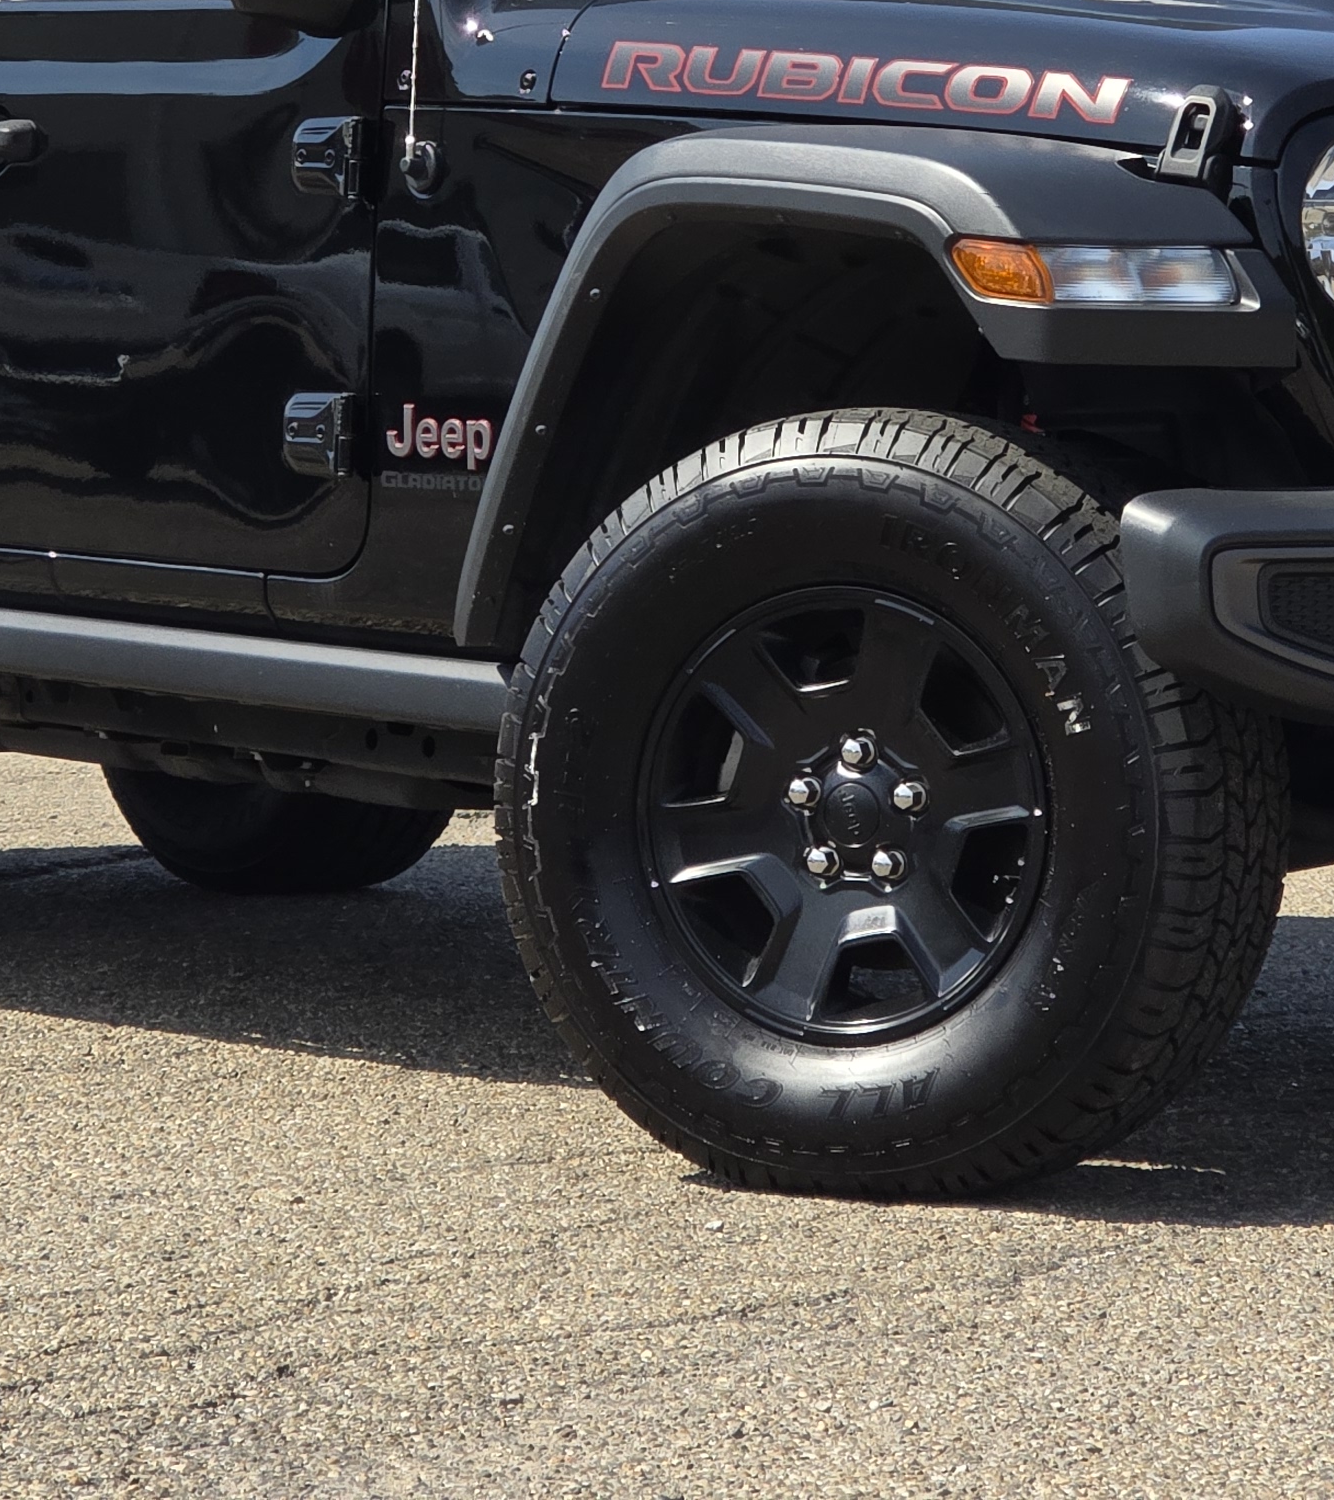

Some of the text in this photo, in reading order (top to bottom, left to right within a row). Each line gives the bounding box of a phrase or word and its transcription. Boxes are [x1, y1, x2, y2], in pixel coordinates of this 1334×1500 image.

[602, 40, 1134, 124] RUBICON
[385, 402, 493, 471] Jeep
[380, 469, 486, 492] GLADIATO
[878, 513, 1093, 737] IRONMAN
[818, 1065, 941, 1124] ALL
